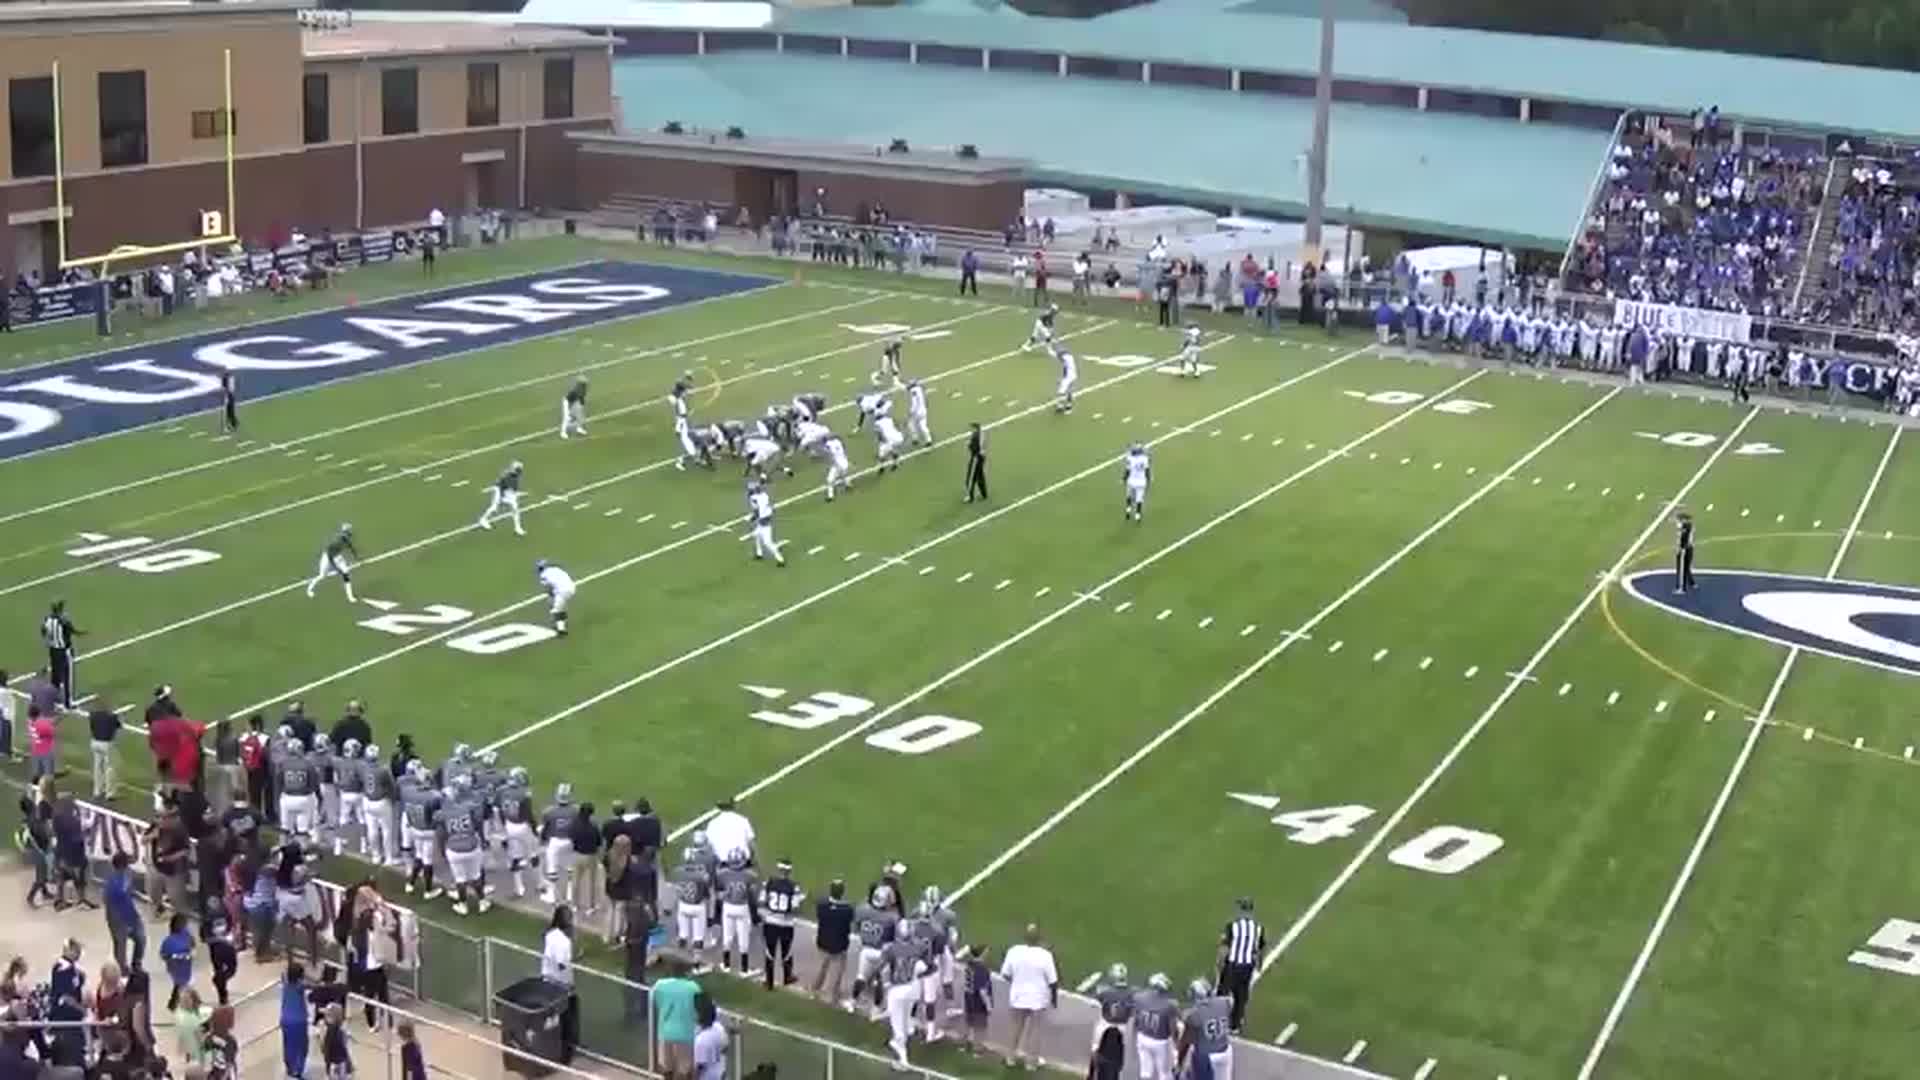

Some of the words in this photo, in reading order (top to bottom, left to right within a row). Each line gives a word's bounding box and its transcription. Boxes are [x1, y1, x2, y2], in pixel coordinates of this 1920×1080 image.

[0, 277, 672, 441] UGARS
[748, 691, 983, 753] 30
[1270, 805, 1504, 875] 40
[768, 891, 790, 911] 28
